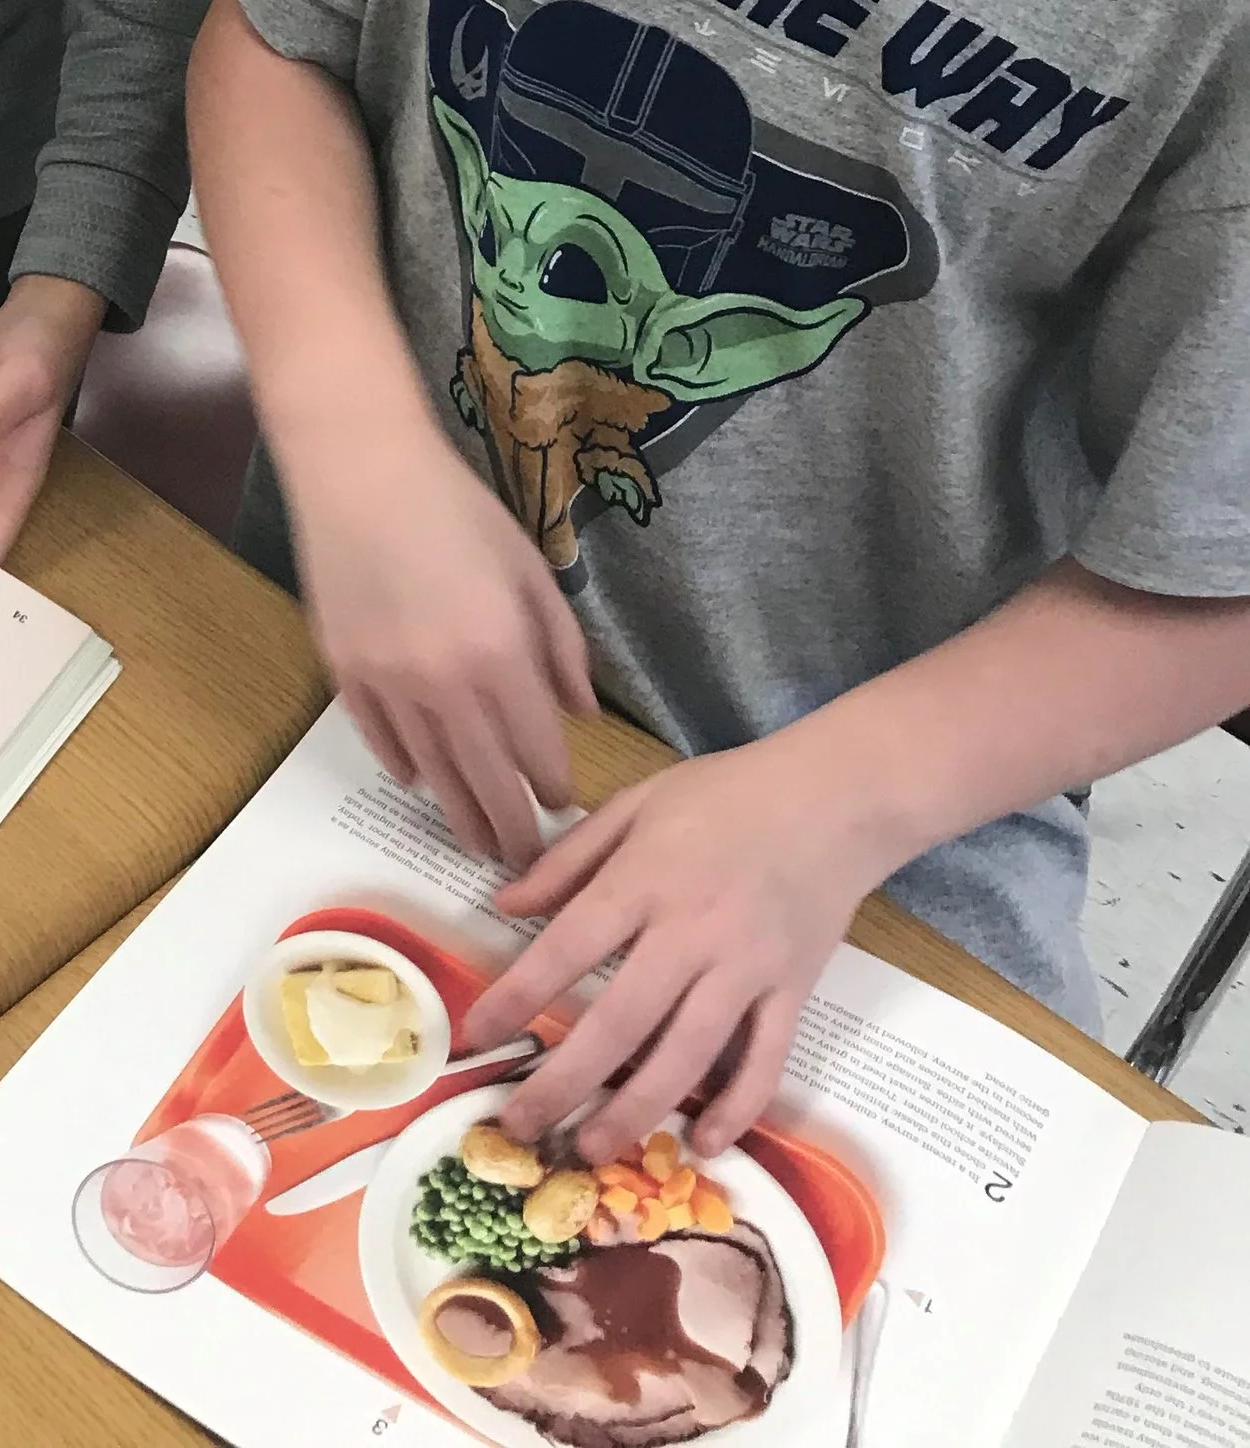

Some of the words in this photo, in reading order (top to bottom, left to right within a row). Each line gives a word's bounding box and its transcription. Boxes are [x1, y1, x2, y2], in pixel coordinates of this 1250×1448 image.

[881, 0, 1131, 171] WAY
[770, 213, 854, 242] STAR
[770, 225, 857, 254] WARS
[814, 1037, 849, 1059] gravy
[848, 1054, 861, 1067] in
[808, 1063, 823, 1076] as
[822, 1071, 852, 1091] meal
[828, 1059, 898, 1103] Traditionally
[860, 1061, 887, 1082] beef
[807, 1077, 832, 1094] and
[888, 1075, 917, 1097] roast
[831, 1089, 878, 1120] children
[852, 1085, 890, 1113] British
[917, 1092, 965, 1125] features
[890, 1107, 929, 1134] classic
[939, 1120, 977, 1147] school
[964, 1120, 975, 1132] it
[929, 1129, 952, 1149] this
[920, 1139, 957, 1167] recent
[952, 1144, 987, 1170] chose
[976, 1143, 1020, 1179] favorite
[967, 1169, 981, 1185] In
[984, 1169, 1014, 1203] 2
[924, 1298, 934, 1314] 1
[371, 1418, 389, 1436] 3
